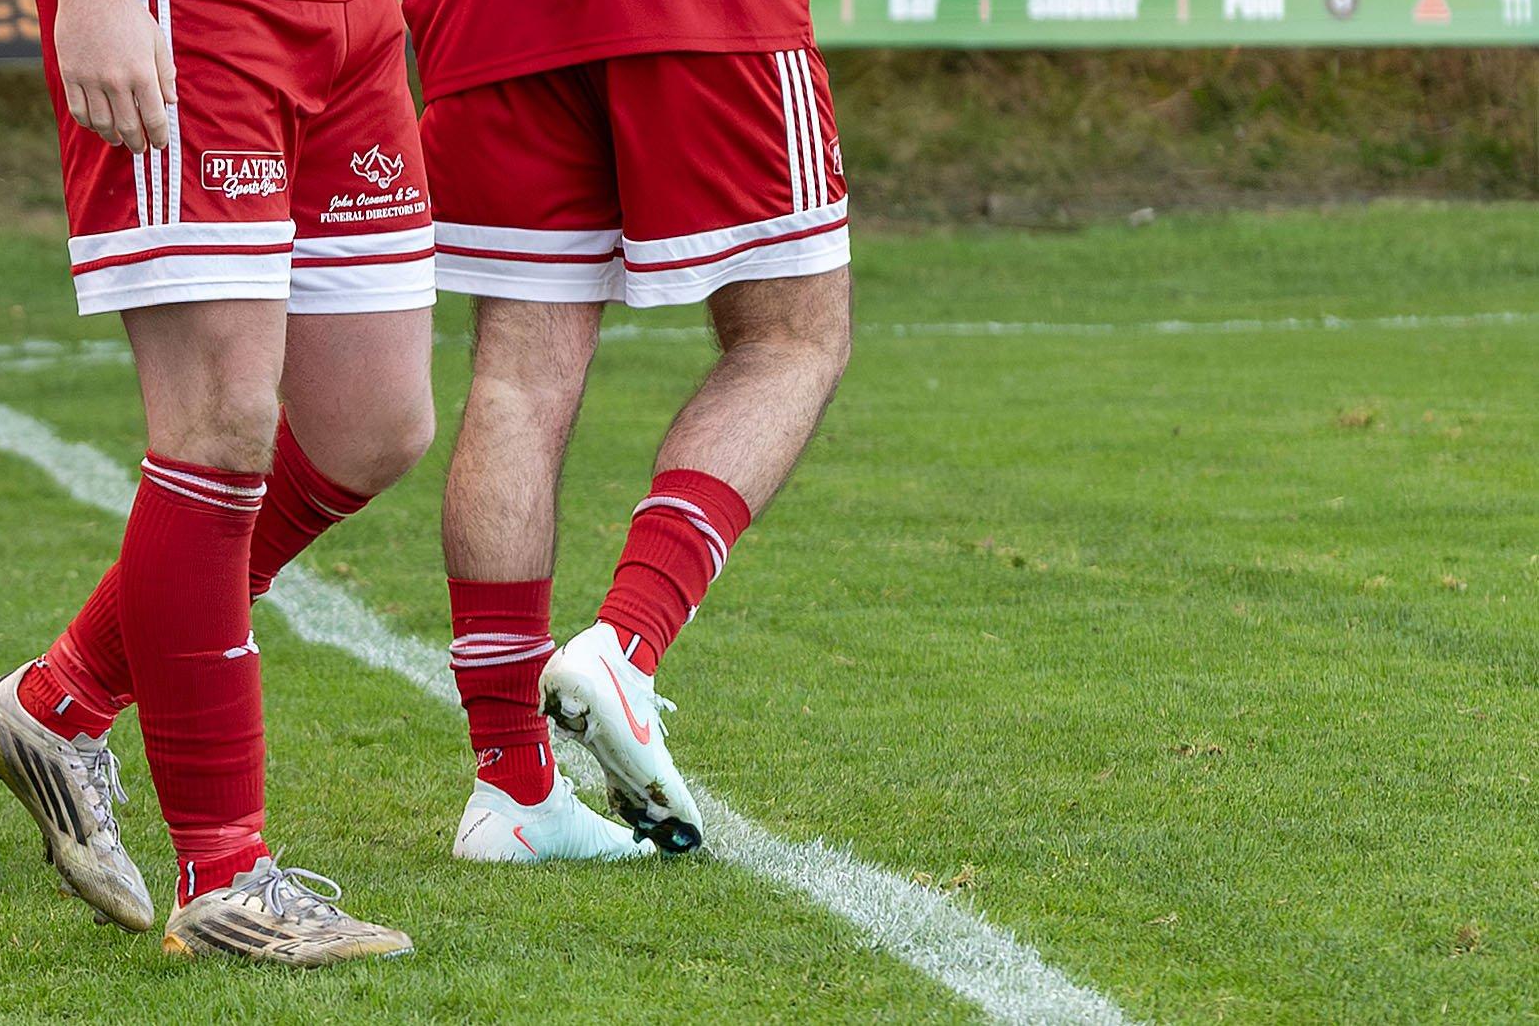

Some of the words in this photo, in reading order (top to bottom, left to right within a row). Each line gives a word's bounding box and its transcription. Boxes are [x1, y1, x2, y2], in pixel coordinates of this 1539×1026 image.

[211, 158, 285, 180] PLAYERS
[222, 177, 260, 200] Sports
[329, 194, 353, 212] John
[395, 187, 404, 201] &
[320, 211, 365, 224] FUNERAL
[365, 206, 413, 220] DIRECTORS
